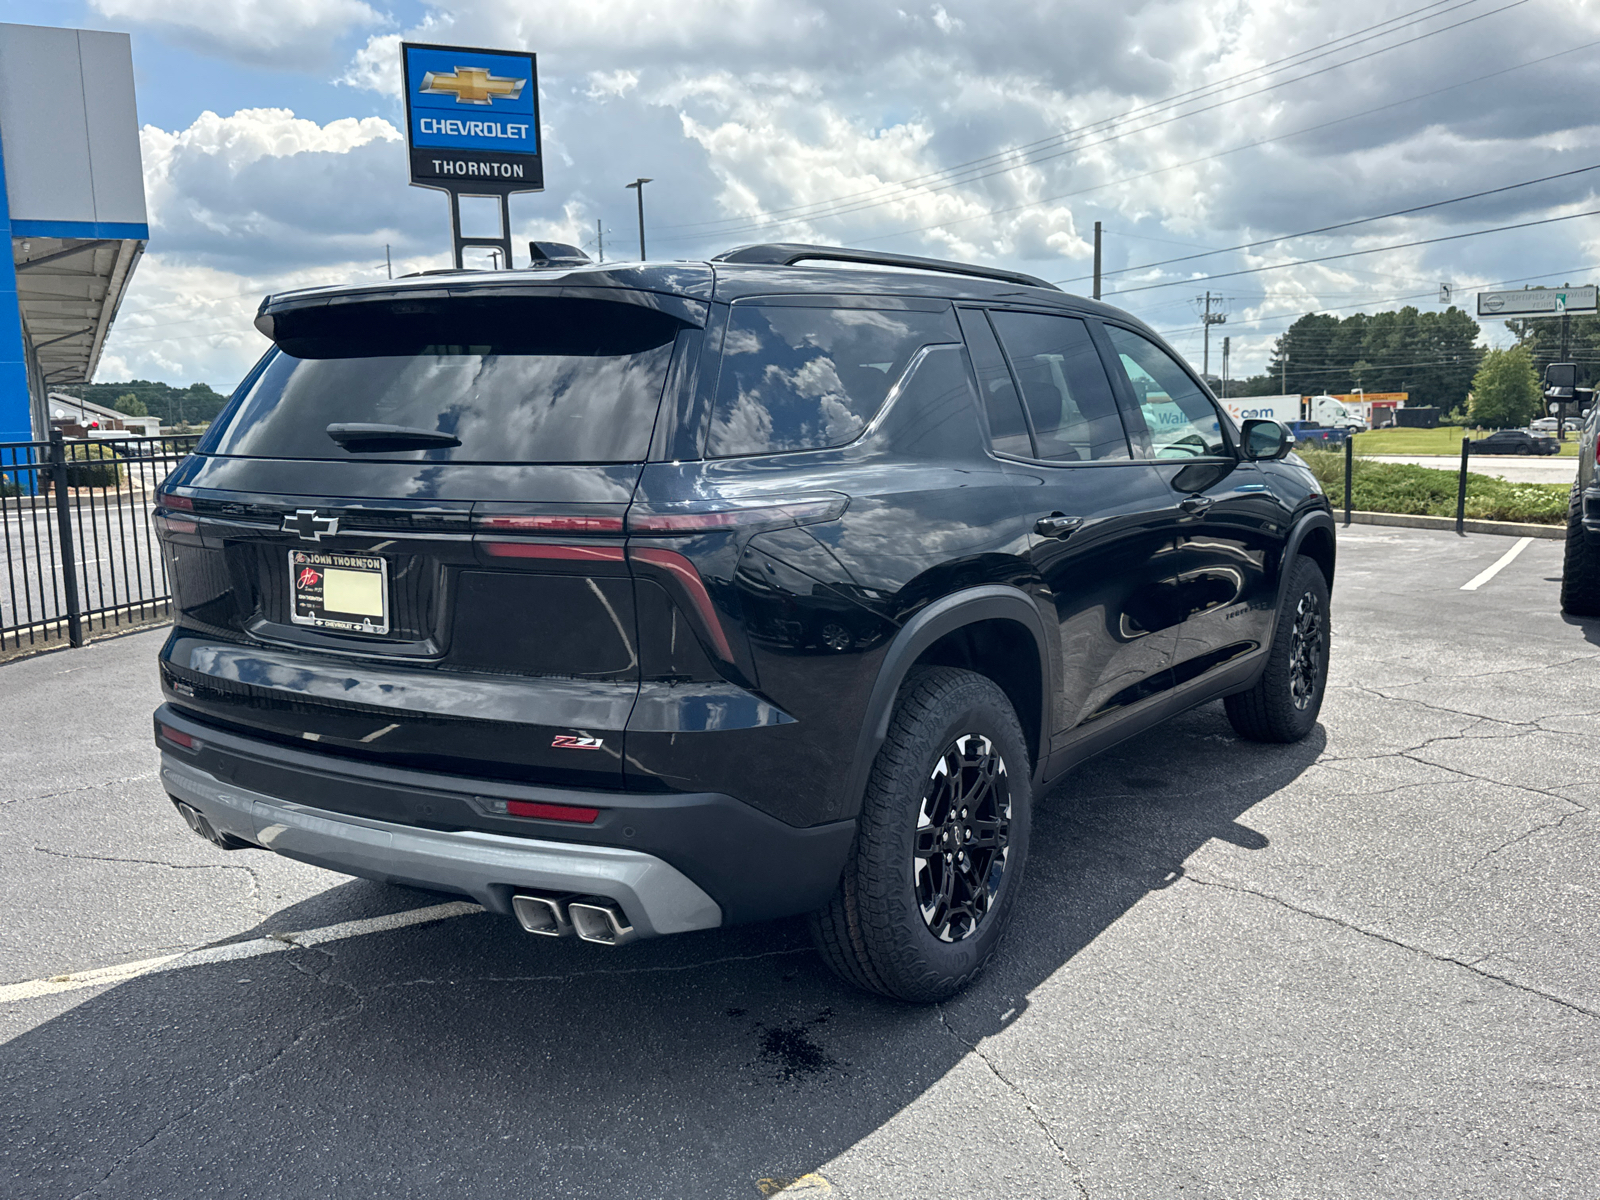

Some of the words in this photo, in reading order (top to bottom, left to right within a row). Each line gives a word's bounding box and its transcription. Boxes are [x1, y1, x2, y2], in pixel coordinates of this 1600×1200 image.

[420, 118, 529, 139] CHEVROLET
[432, 160, 524, 178] THORNTON
[310, 554, 332, 565] JOHN
[333, 556, 380, 569] THORNTON
[324, 620, 353, 629] CHEVROLET
[551, 735, 604, 750] Z71
